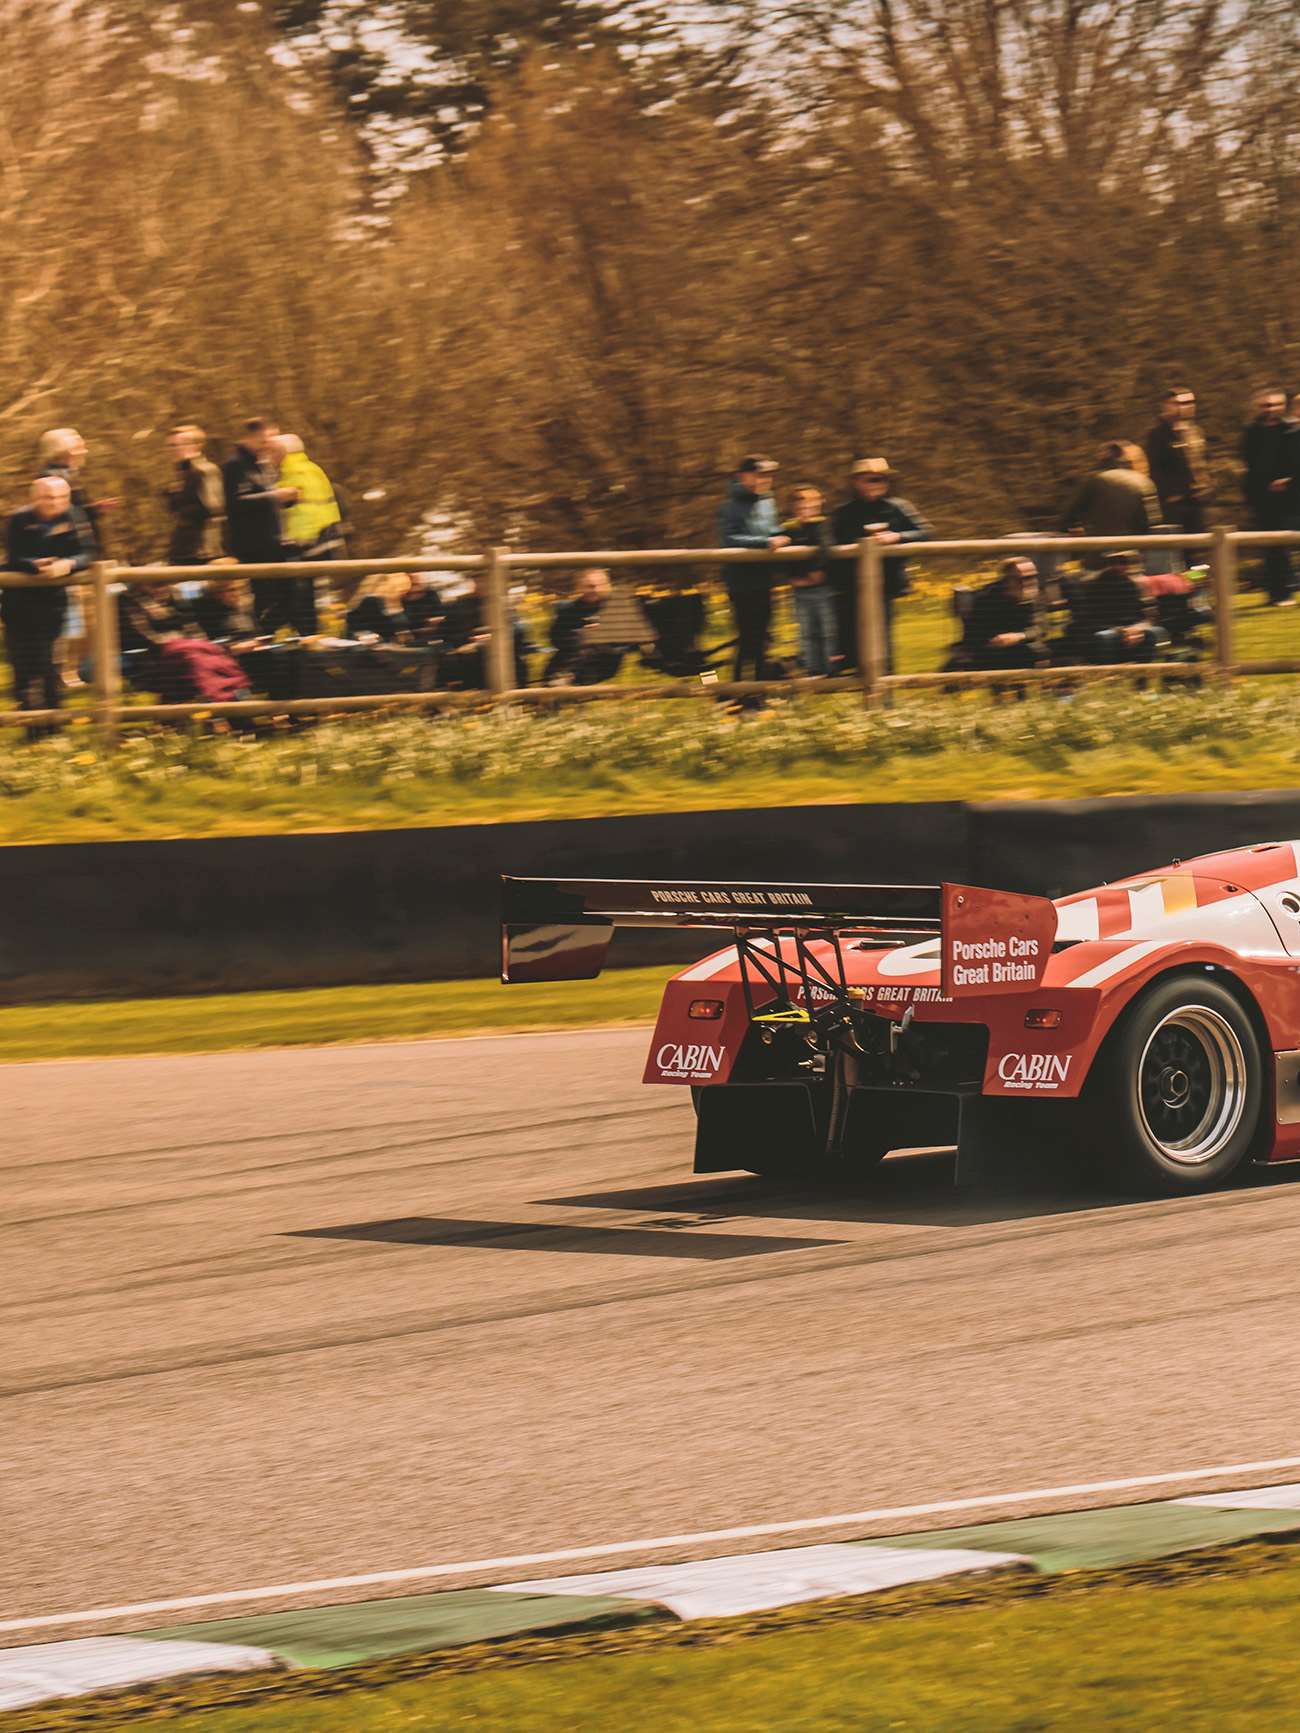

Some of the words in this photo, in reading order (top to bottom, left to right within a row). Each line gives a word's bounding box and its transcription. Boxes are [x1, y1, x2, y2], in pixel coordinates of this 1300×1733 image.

[651, 890, 701, 902] PORSCHE
[700, 891, 731, 904] CARS
[731, 892, 767, 904] GREAT
[767, 892, 813, 905] BRITAIN
[952, 938, 1006, 960] Porsche
[1009, 936, 1039, 957] Cars
[953, 964, 989, 985] Great
[992, 960, 1036, 983] Britain
[877, 986, 911, 1001] GREAT
[913, 986, 953, 1002] BRITA
[656, 1043, 726, 1071] CABIN
[998, 1053, 1073, 1081] CABIN
